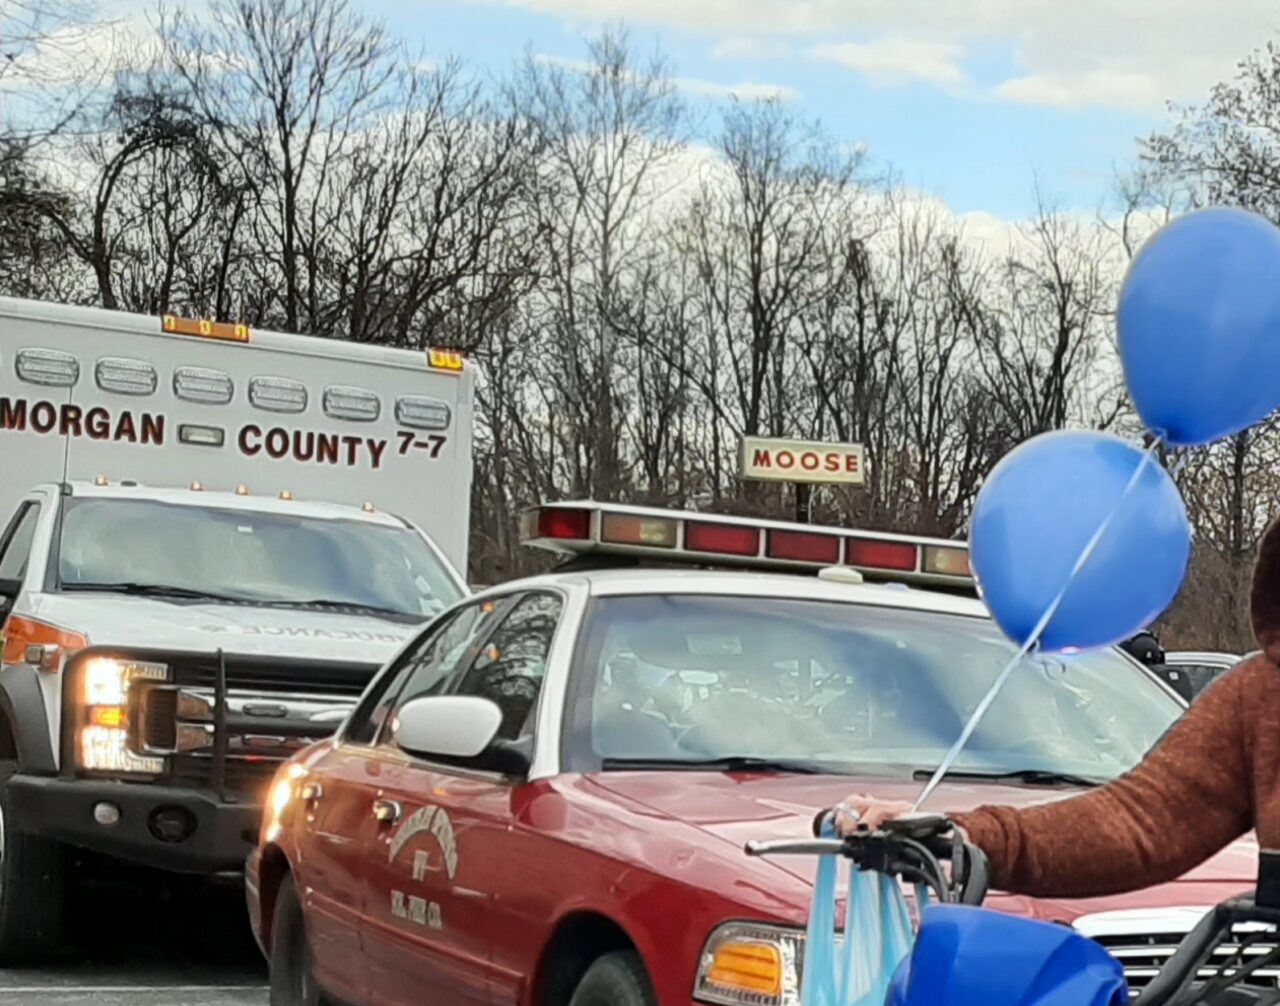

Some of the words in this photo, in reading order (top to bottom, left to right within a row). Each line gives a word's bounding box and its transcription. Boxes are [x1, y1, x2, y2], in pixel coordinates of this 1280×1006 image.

[0, 397, 165, 446] MORGAN
[237, 424, 388, 469] COUNTY
[396, 430, 447, 459] 7-7
[752, 448, 858, 472] MOOSE
